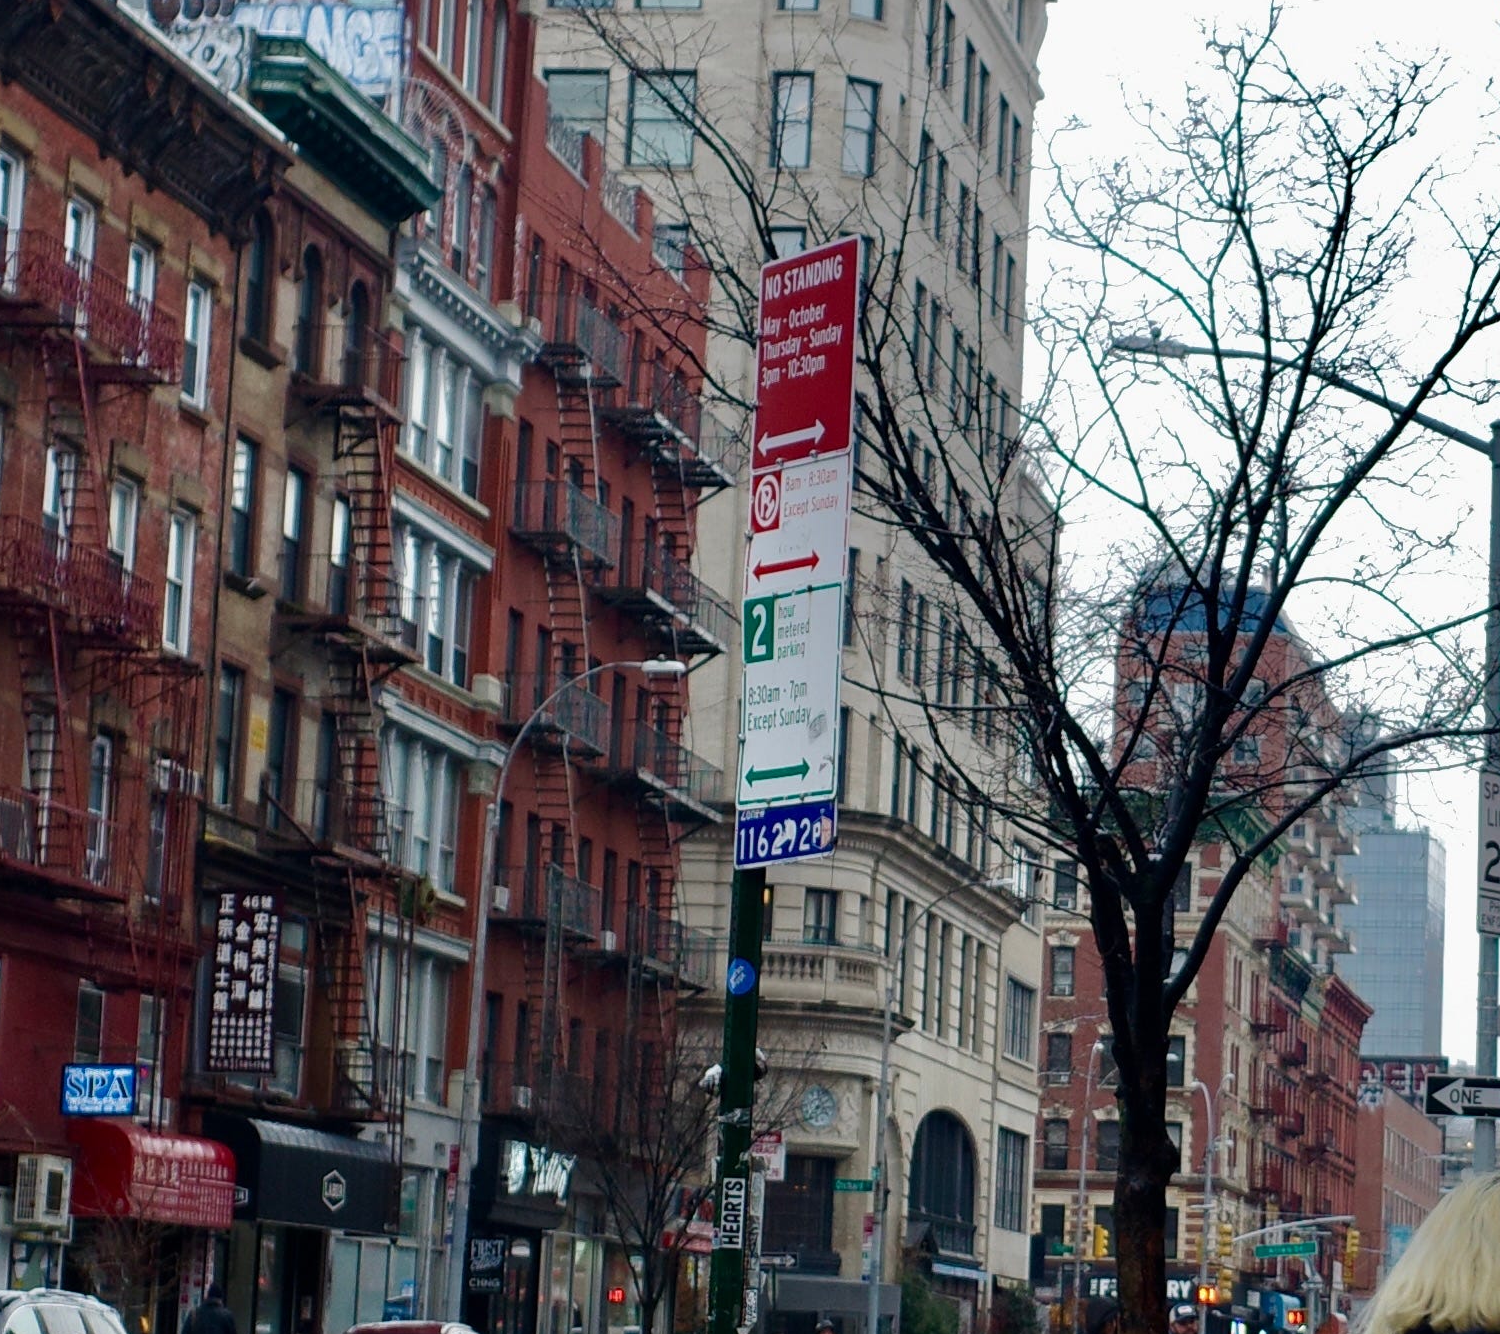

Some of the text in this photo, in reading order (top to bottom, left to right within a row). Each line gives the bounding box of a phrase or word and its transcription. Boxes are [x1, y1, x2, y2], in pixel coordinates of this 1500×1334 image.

[765, 255, 843, 301] NO STANDING
[763, 316, 781, 337] May
[789, 303, 826, 329] October
[763, 336, 801, 361] Thursday
[809, 324, 843, 348] Sunday
[761, 367, 780, 389] 3pm
[788, 354, 825, 379] 10:30pm
[809, 469, 838, 487] 8:30am
[784, 494, 839, 518] Except Sunday
[778, 603, 796, 618] hour
[751, 603, 767, 657] 2
[778, 619, 810, 640] metered
[777, 641, 805, 662] parking
[749, 685, 780, 706] 8:30am
[789, 680, 807, 702] 7pm
[748, 705, 812, 732] Except Sunday
[66, 1072, 130, 1099] SPA
[1449, 1089, 1483, 1105] ONE
[722, 1180, 743, 1246] HEARTS
